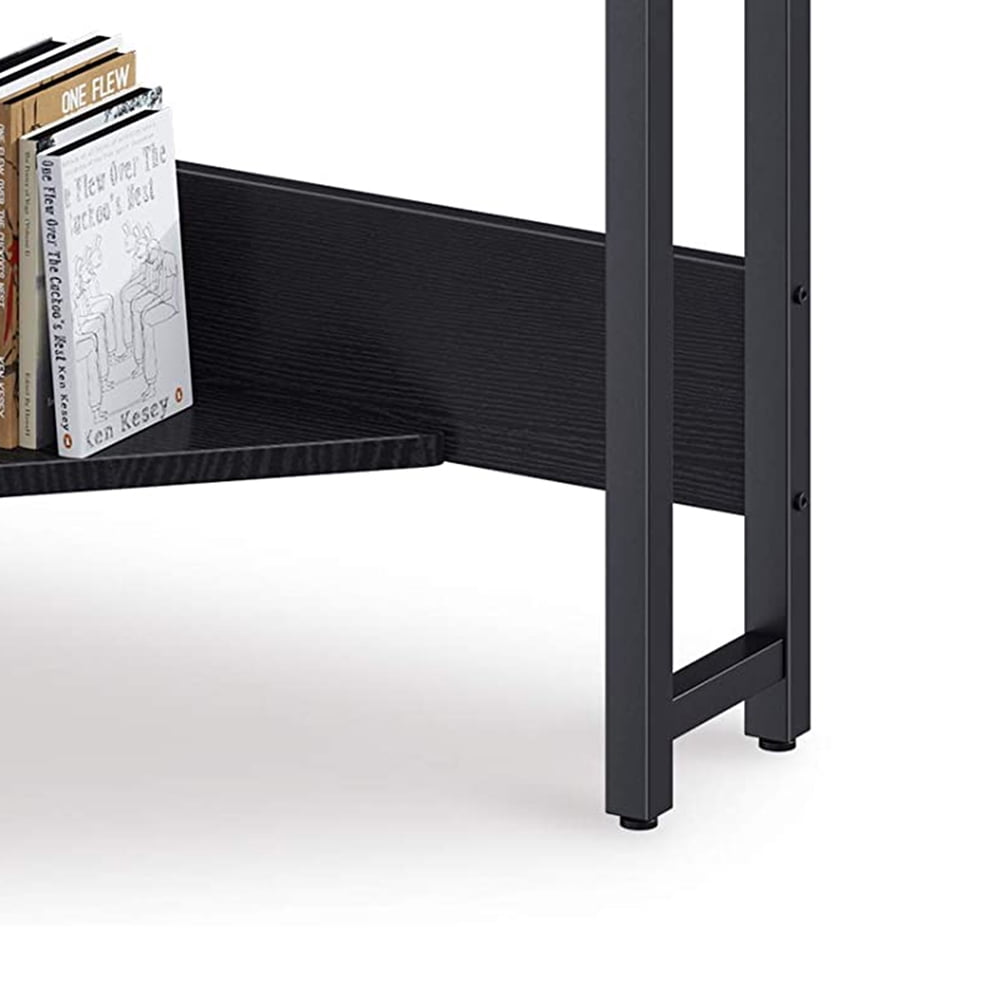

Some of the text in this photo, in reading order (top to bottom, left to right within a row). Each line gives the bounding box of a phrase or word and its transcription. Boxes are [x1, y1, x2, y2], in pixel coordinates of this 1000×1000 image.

[61, 86, 88, 114] ONE
[91, 64, 130, 101] FLEW
[74, 172, 106, 201] Flew
[109, 155, 138, 186] Over
[143, 144, 168, 172] The
[126, 177, 156, 212] Nest
[41, 160, 70, 431] One Flew Over The Cuckoo's Nest Ken Kesey
[120, 395, 170, 433] Kesey
